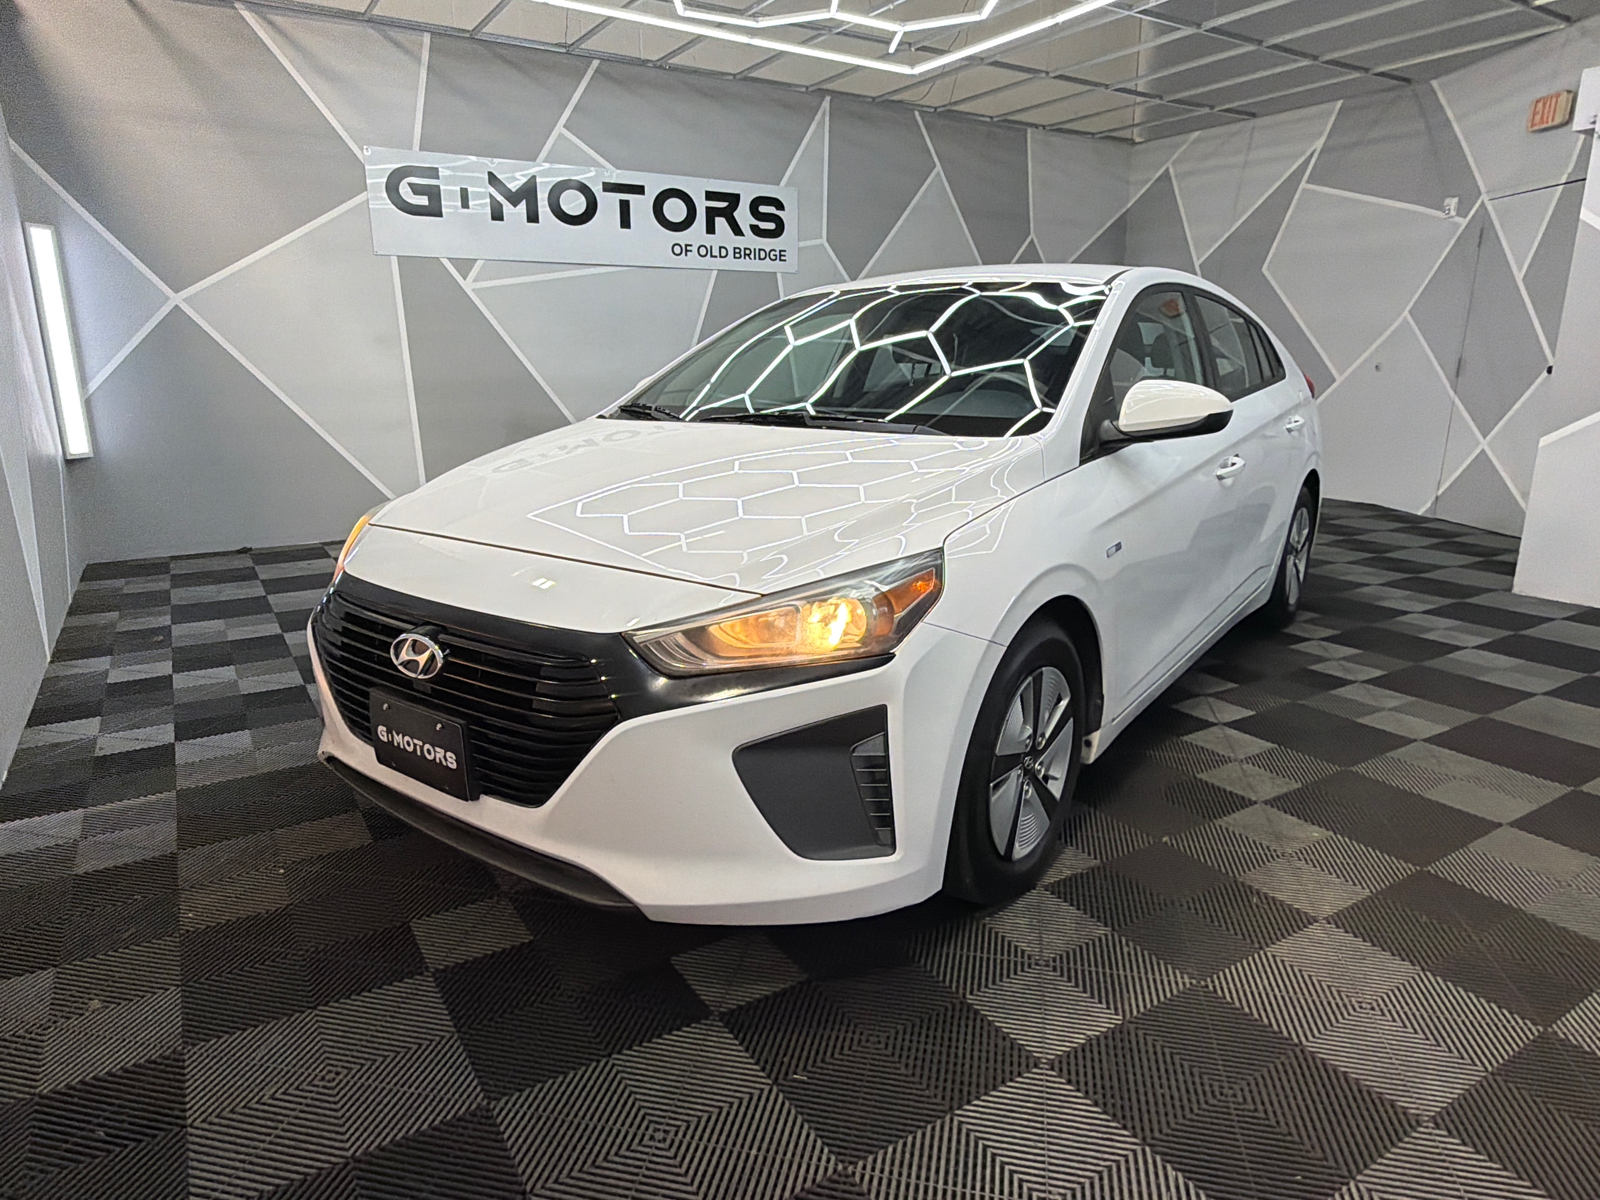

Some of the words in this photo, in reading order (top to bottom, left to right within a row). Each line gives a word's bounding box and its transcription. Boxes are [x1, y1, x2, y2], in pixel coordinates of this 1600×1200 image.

[1530, 92, 1562, 129] EXIT
[670, 242, 693, 257] OF
[696, 244, 729, 259] OLD
[732, 246, 788, 263] BRIDGE
